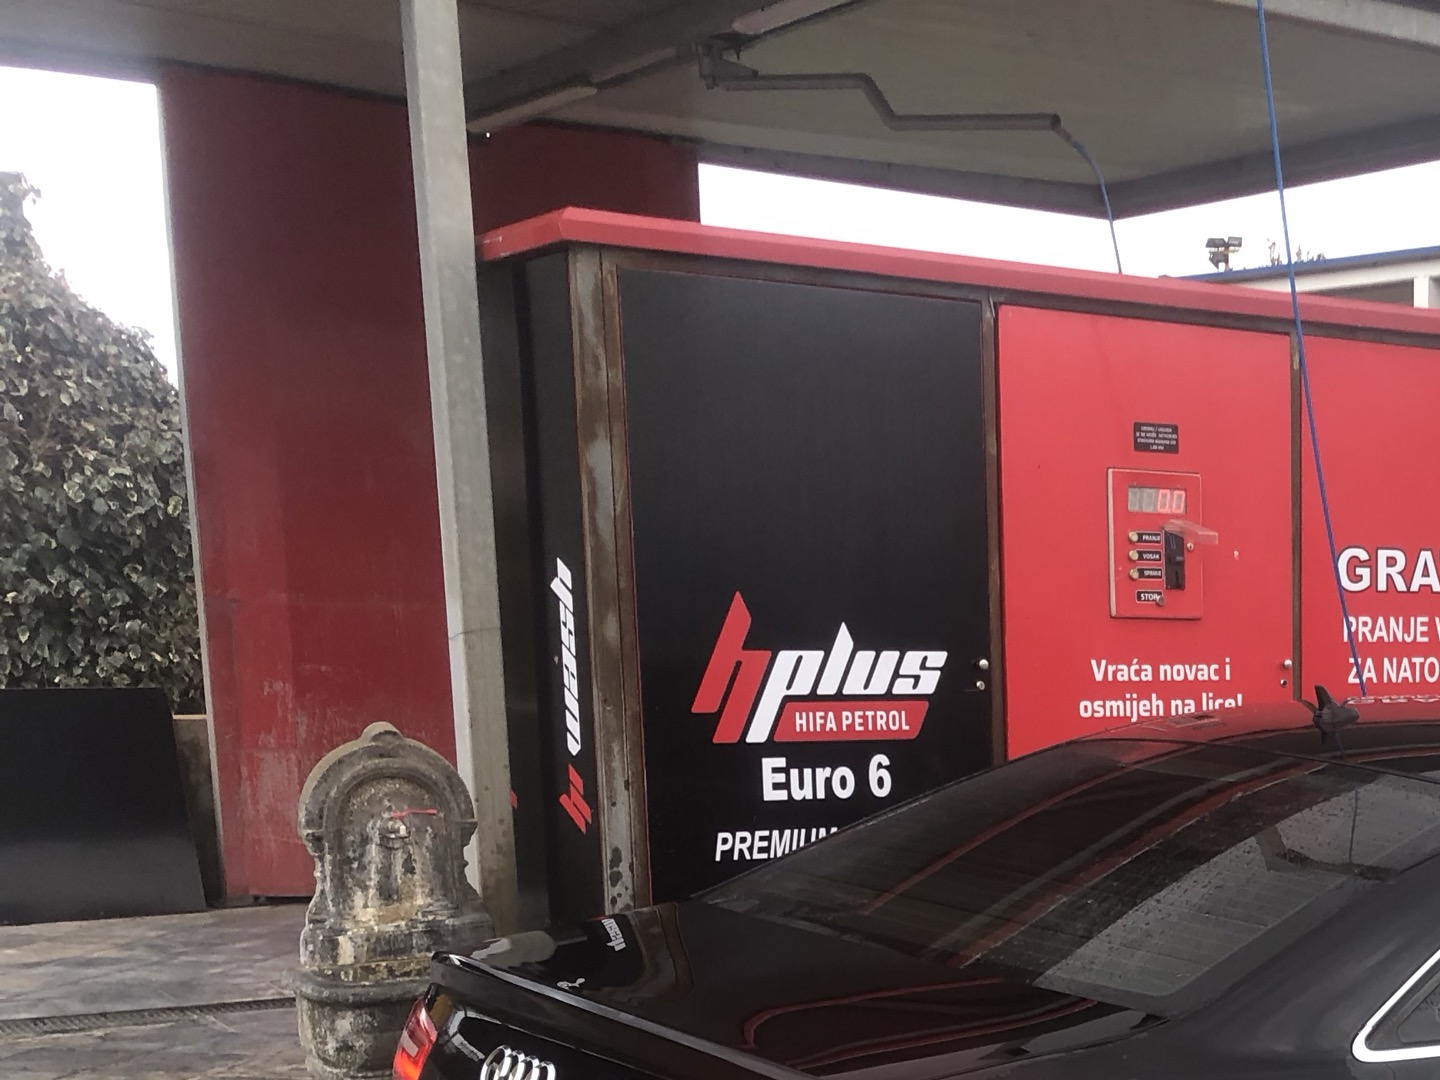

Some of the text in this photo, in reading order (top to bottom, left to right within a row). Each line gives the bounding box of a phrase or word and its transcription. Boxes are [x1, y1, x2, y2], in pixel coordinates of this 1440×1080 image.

[1343, 616, 1429, 643] PRANJE
[691, 591, 948, 743] hplus
[1090, 657, 1231, 682] Vraća novac i
[1347, 657, 1377, 684] ZA
[795, 710, 910, 732] HIFA PETROL
[1079, 693, 1164, 723] osmijeh
[1170, 699, 1196, 716] na
[761, 753, 892, 802] Euro 6
